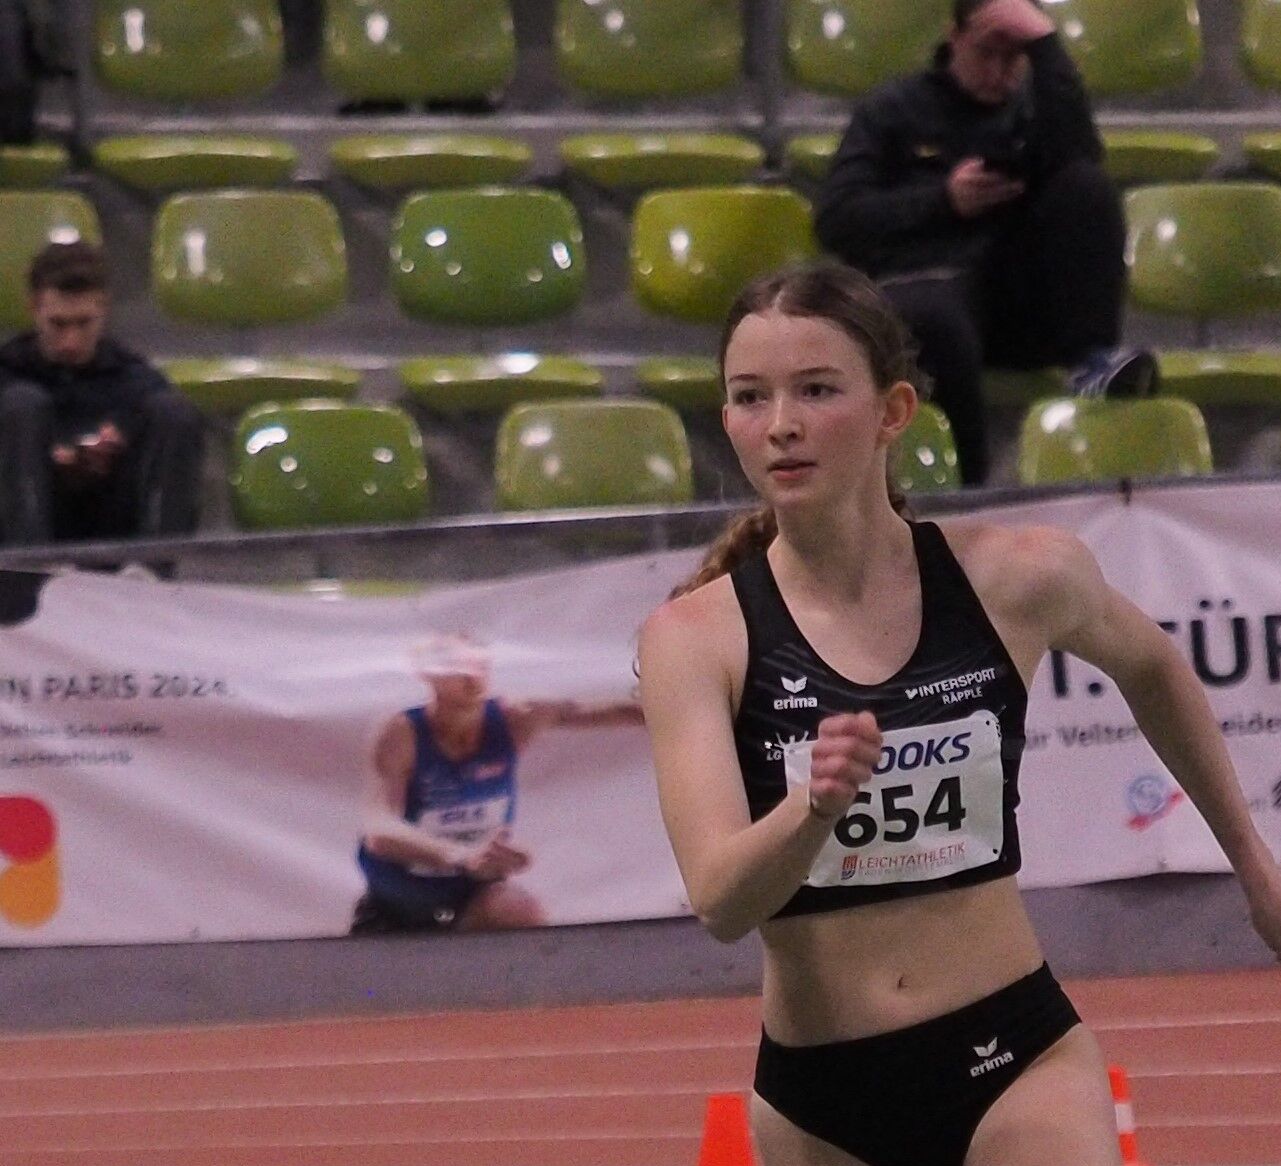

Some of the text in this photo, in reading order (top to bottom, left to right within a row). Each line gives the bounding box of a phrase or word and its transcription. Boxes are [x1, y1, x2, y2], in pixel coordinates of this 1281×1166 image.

[44, 672, 140, 701] PARIS
[152, 672, 229, 698] 2024
[919, 668, 996, 697] INTERSPORT
[774, 696, 818, 710] erima
[872, 732, 972, 775] OOKS
[834, 776, 966, 848] 654
[859, 842, 965, 870] LEICHTATHLETIK
[970, 1052, 1014, 1077] erima
